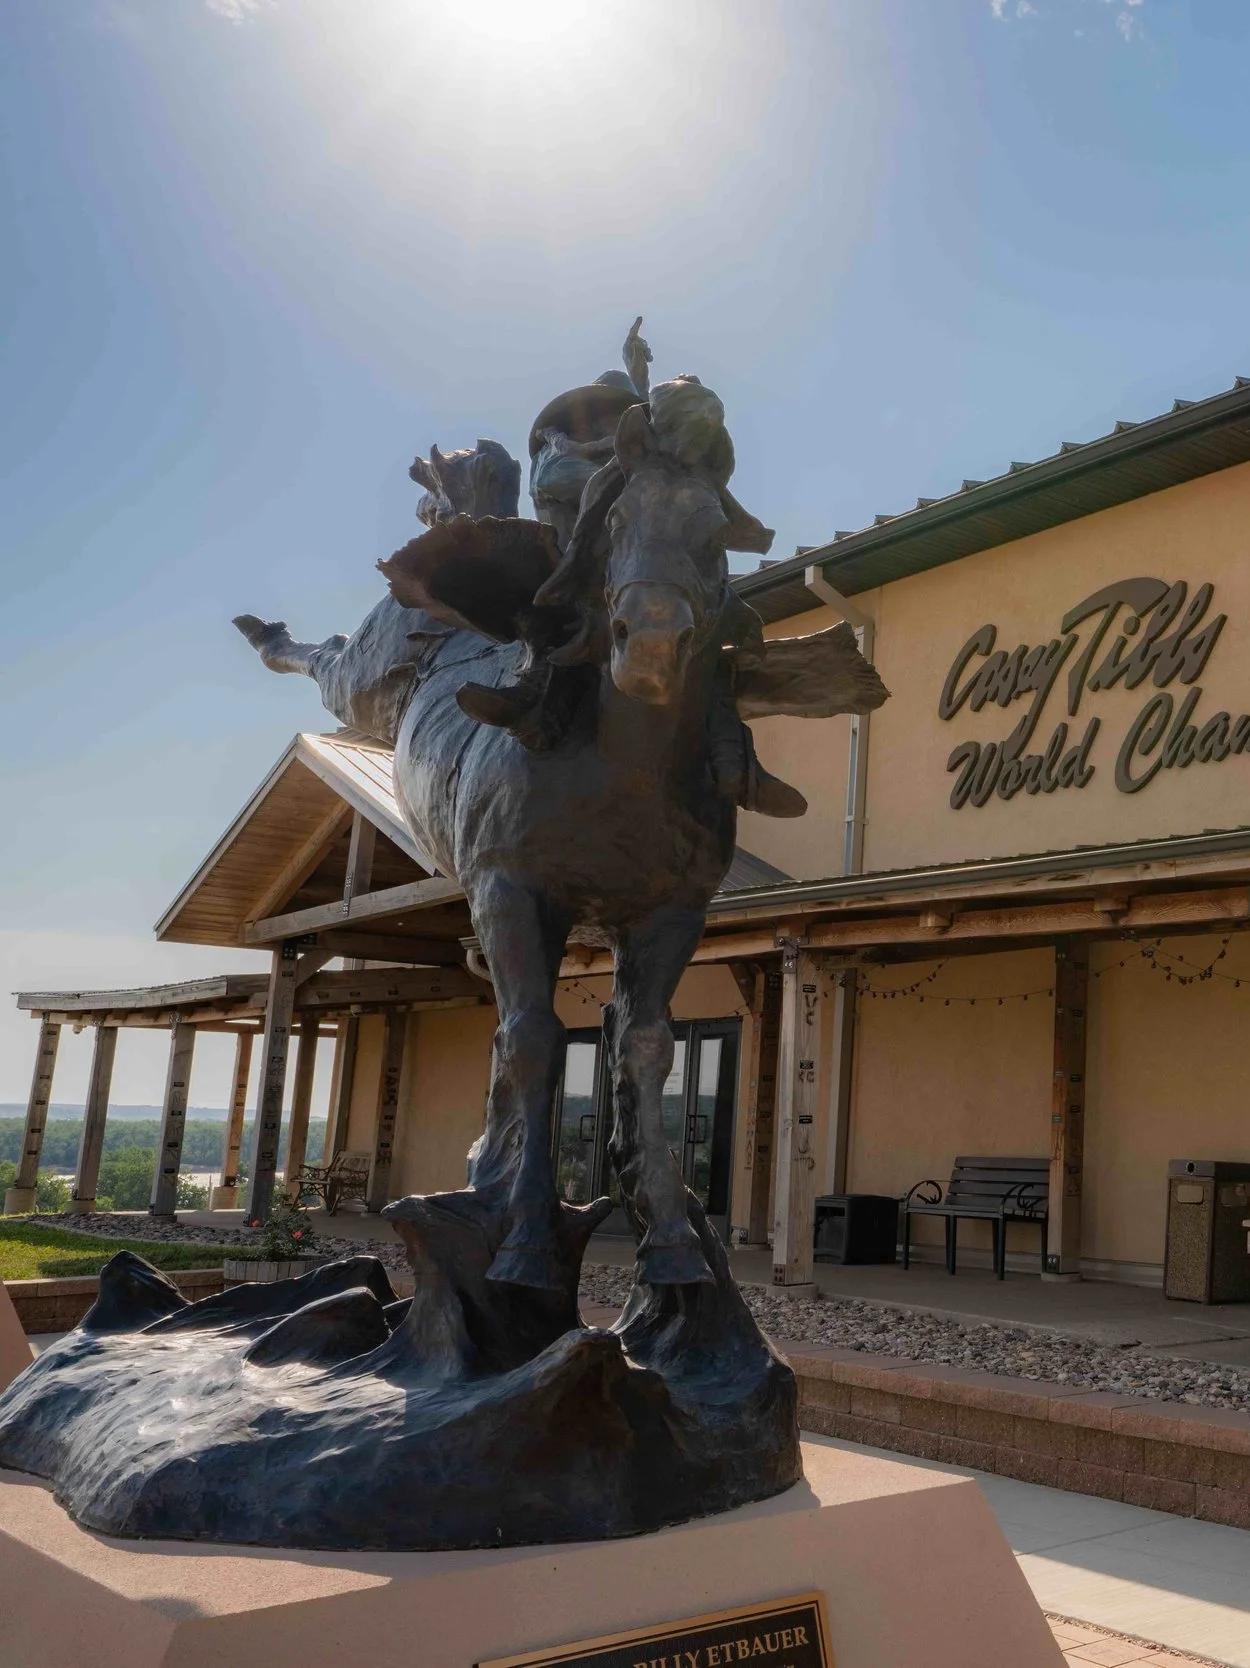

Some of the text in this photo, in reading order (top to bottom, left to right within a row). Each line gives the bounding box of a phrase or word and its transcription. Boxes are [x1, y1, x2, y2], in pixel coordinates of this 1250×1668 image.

[938, 576, 1228, 759] Casey Tibbs
[947, 717, 1101, 810] World
[633, 1626, 810, 1668] LLY ETBAUER
